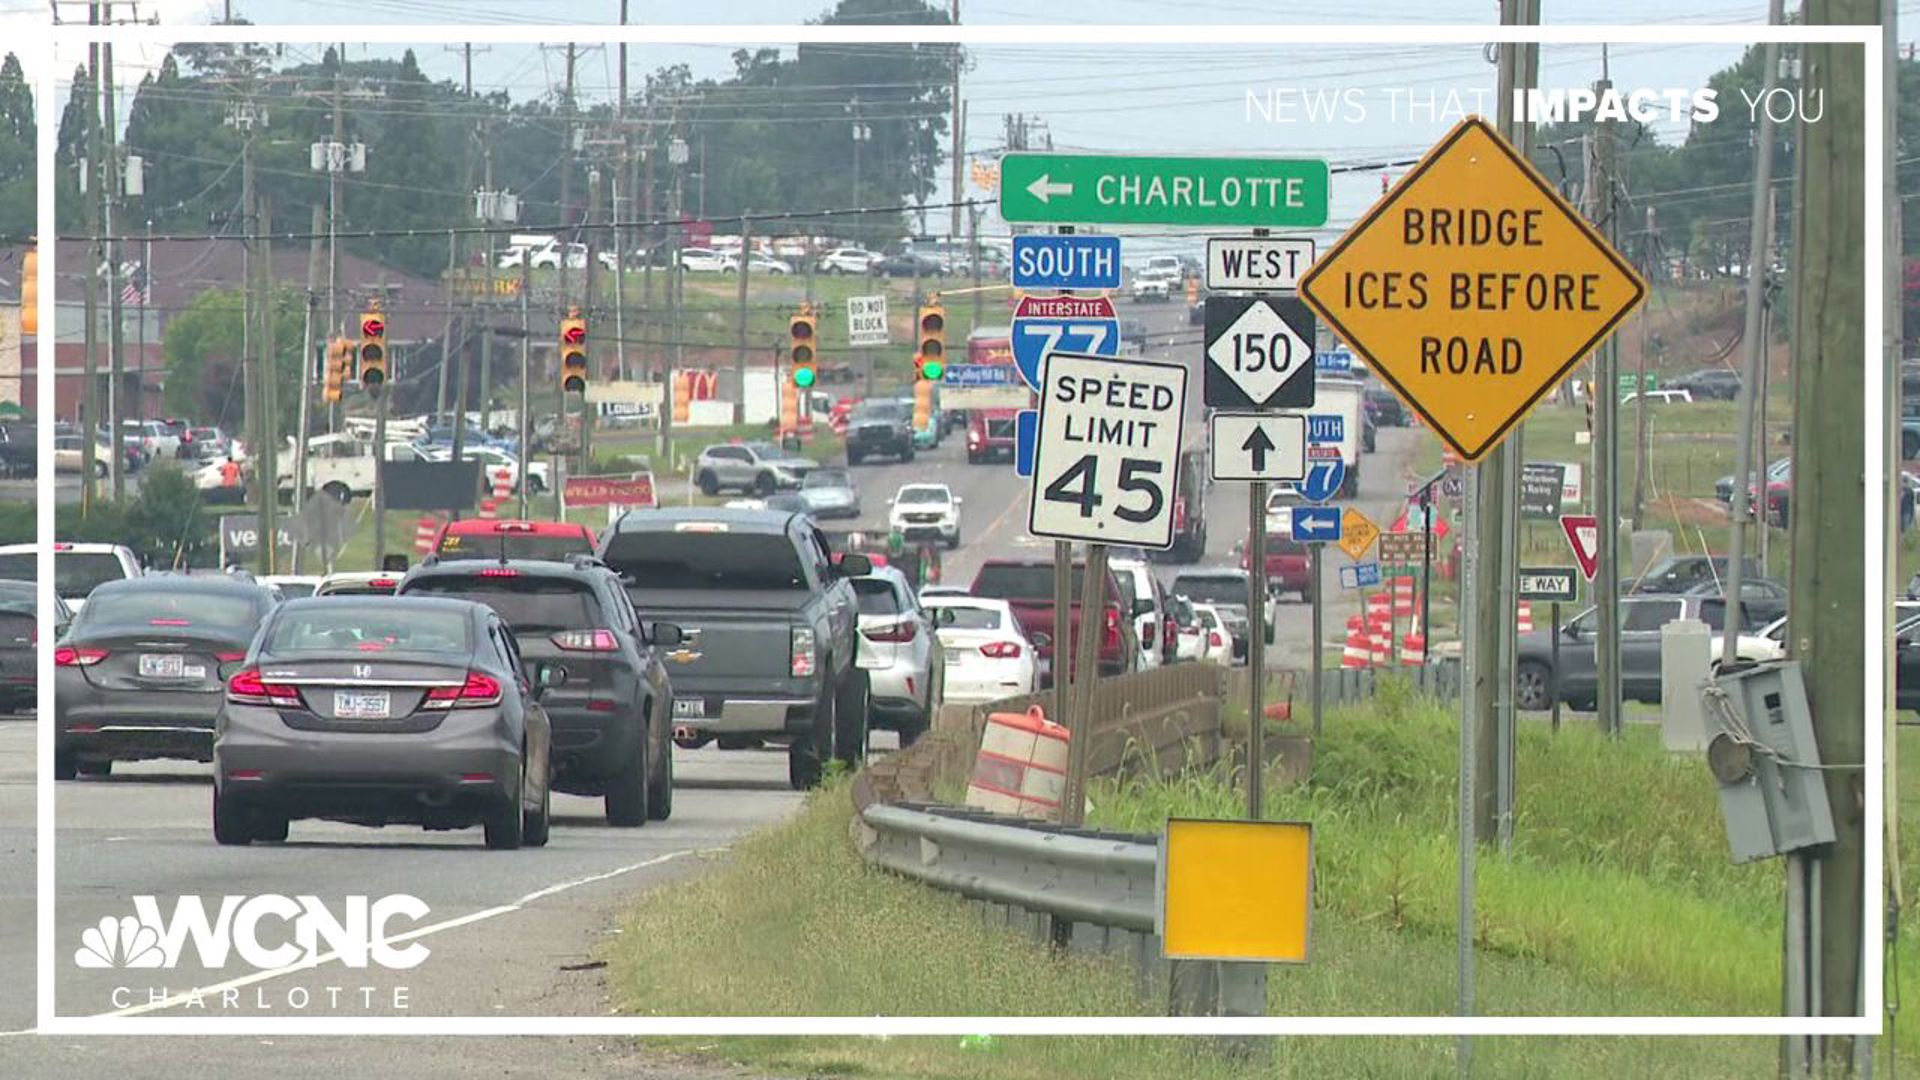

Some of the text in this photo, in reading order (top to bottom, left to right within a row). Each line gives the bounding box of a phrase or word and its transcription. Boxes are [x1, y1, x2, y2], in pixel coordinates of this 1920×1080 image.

[1096, 174, 1305, 208] CHARLOTTE
[1403, 208, 1544, 248] BRIDGE
[1019, 246, 1113, 279] SOUTH
[1221, 248, 1301, 280] WEST
[867, 300, 884, 313] NOT
[1344, 271, 1600, 312] ICES BEFORE
[853, 317, 884, 331] BLOCK
[1027, 302, 1103, 317] INTERSTATE
[1023, 324, 1108, 384] 77
[1232, 332, 1292, 373] 150
[1421, 336, 1524, 376] ROAD
[1055, 375, 1175, 411] SPEED
[1064, 415, 1158, 448] LIMIT
[1308, 419, 1342, 438] UTH
[1043, 454, 1164, 524] 45
[1536, 577, 1566, 592] WAY
